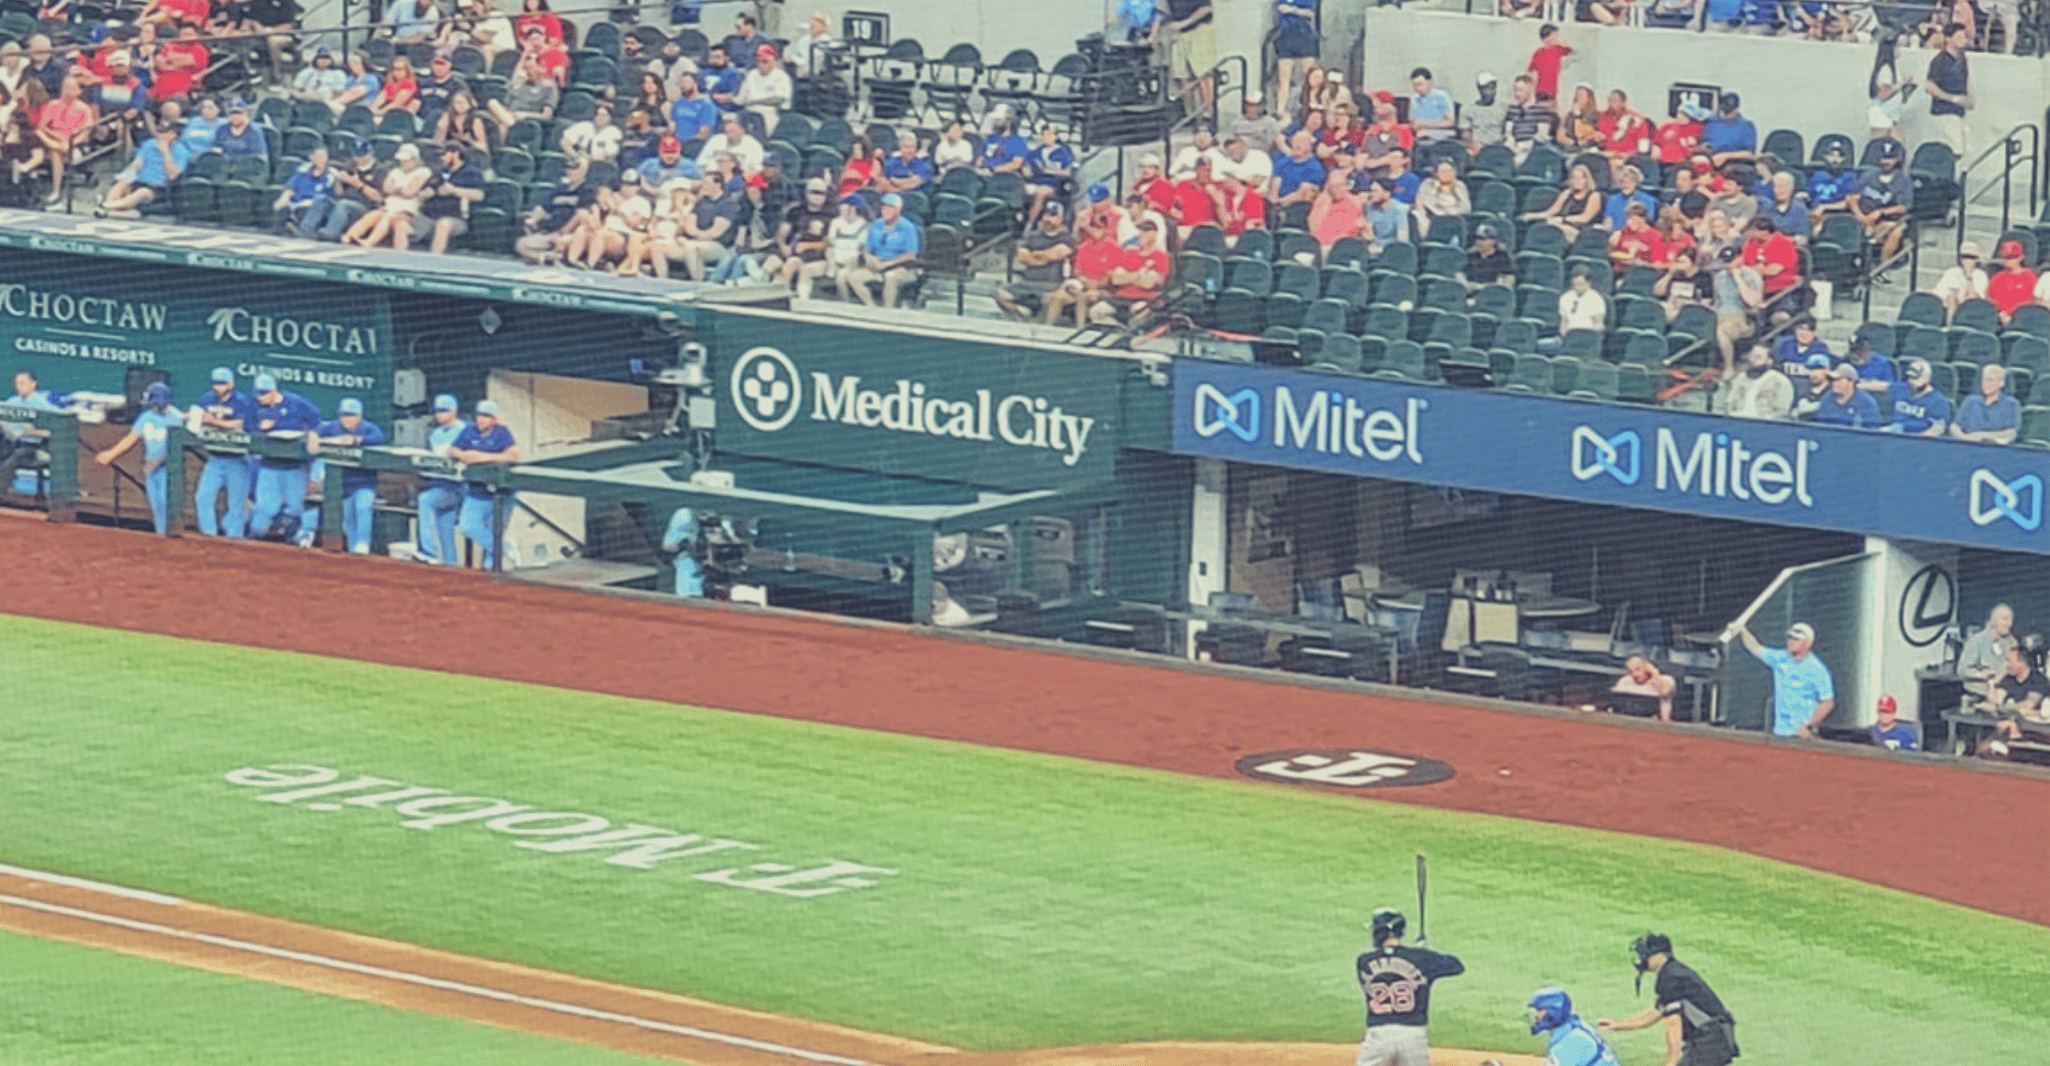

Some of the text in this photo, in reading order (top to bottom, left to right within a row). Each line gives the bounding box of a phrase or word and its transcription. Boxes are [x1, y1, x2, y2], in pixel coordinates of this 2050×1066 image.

[3, 284, 168, 332] CHOCTAW
[14, 337, 156, 366] CASINOS & RESORTS
[304, 370, 316, 384] &
[811, 371, 1095, 466] Medical City
[1274, 386, 1424, 464] Mitel
[1655, 427, 1814, 507] Mitel
[1367, 981, 1415, 1015] 28
